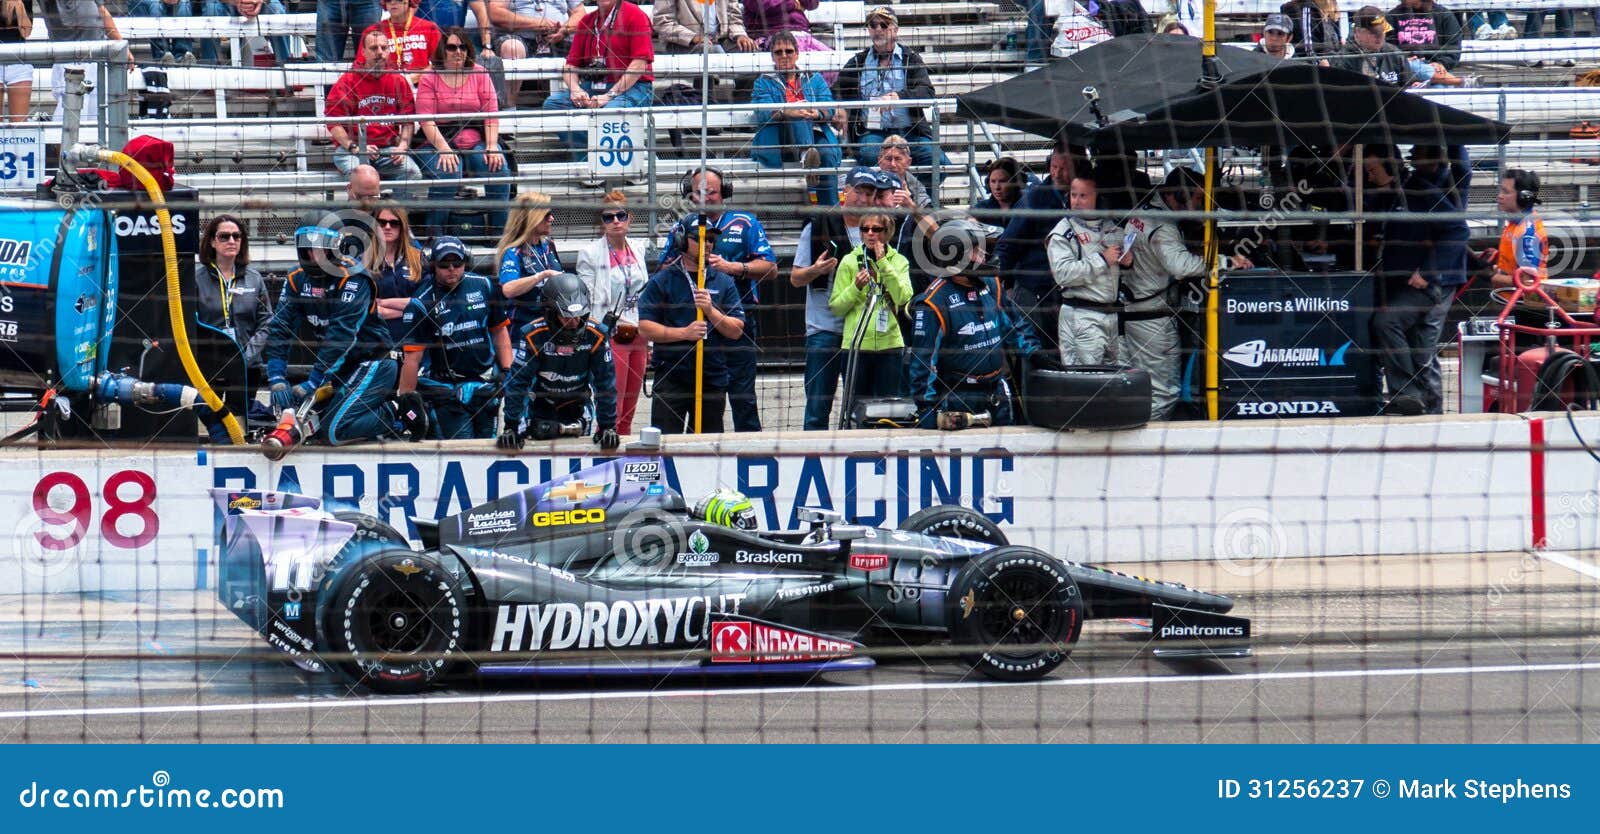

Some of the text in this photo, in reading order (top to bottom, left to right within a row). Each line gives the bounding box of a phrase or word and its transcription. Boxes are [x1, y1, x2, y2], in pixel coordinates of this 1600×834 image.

[602, 121, 631, 134] SEC
[599, 135, 634, 167] 30
[0, 151, 35, 180] 31
[115, 214, 187, 237] OASS
[0, 239, 32, 266] DA
[1227, 299, 1282, 313] Bowers
[1295, 297, 1350, 312] Wilkins
[1222, 340, 1320, 367] BARRACUDA
[1236, 401, 1341, 415] HONDA
[625, 463, 658, 473] IZOD
[736, 447, 1014, 532] RACING
[32, 470, 160, 550] 98
[468, 510, 516, 523] American
[532, 508, 606, 527] GEICO
[473, 519, 512, 528] Racing
[678, 553, 719, 563] EXPO 2020
[735, 550, 803, 563] Braskem
[855, 557, 885, 568] bryant
[272, 556, 314, 592] 11
[996, 558, 1065, 584] Firestone
[776, 583, 835, 600] Firestone
[285, 604, 300, 617] M
[273, 619, 303, 644] verizon
[491, 593, 747, 652] HYDROXYCUT
[1161, 624, 1244, 638] plantronics
[268, 632, 321, 670] Firesne
[723, 629, 745, 654] K
[982, 651, 1047, 672] Fireston
